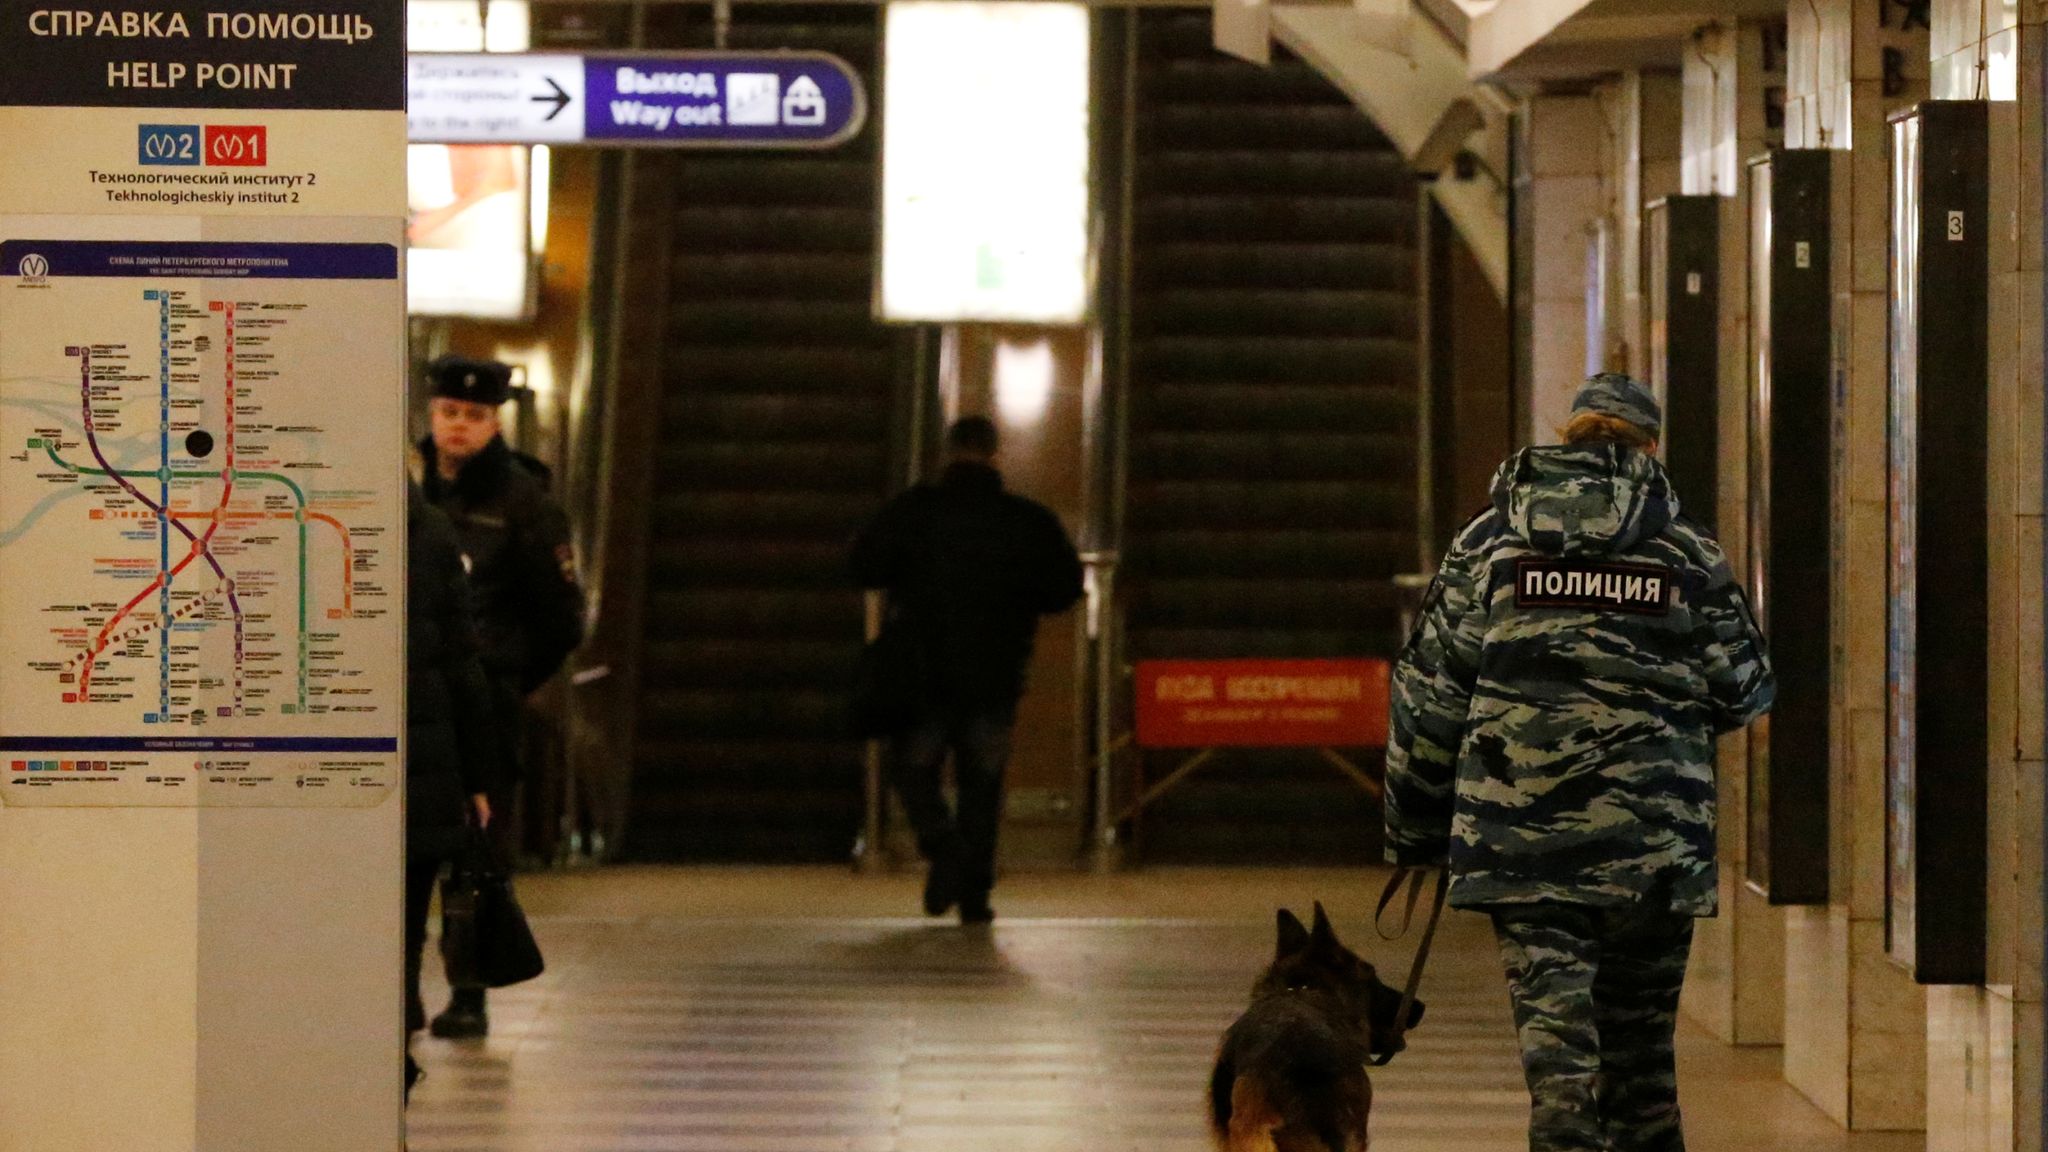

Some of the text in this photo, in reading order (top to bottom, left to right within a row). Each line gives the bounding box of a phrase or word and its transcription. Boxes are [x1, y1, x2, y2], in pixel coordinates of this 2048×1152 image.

[28, 10, 374, 44] СПРАВКА ПОМОЩЬ
[107, 62, 297, 90] HELP POINT
[616, 66, 718, 98] Выход
[610, 100, 722, 131] Way out
[89, 170, 316, 188] Технологический институт 2
[106, 190, 299, 206] Tekhnologicheskiy institut 2
[1950, 216, 1962, 235] 3
[1525, 570, 1661, 603] ПОЛИЦИЯ
